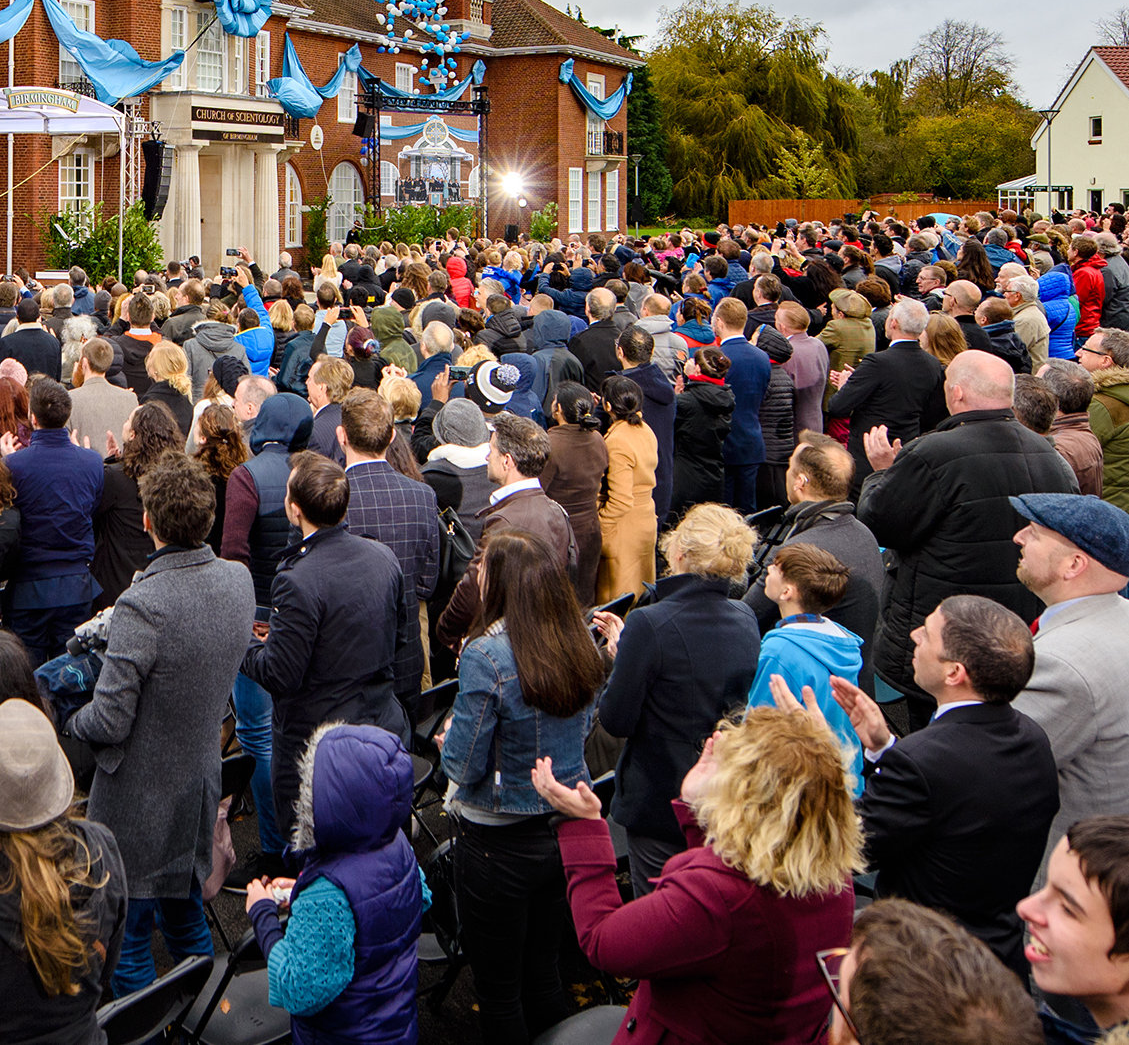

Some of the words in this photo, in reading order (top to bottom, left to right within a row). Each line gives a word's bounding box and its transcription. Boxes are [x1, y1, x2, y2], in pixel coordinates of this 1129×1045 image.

[15, 93, 75, 110] BIRMINGHAM
[196, 108, 226, 121] CHURCH
[227, 112, 234, 121] OF
[235, 111, 280, 124] SCIENTOLOGY
